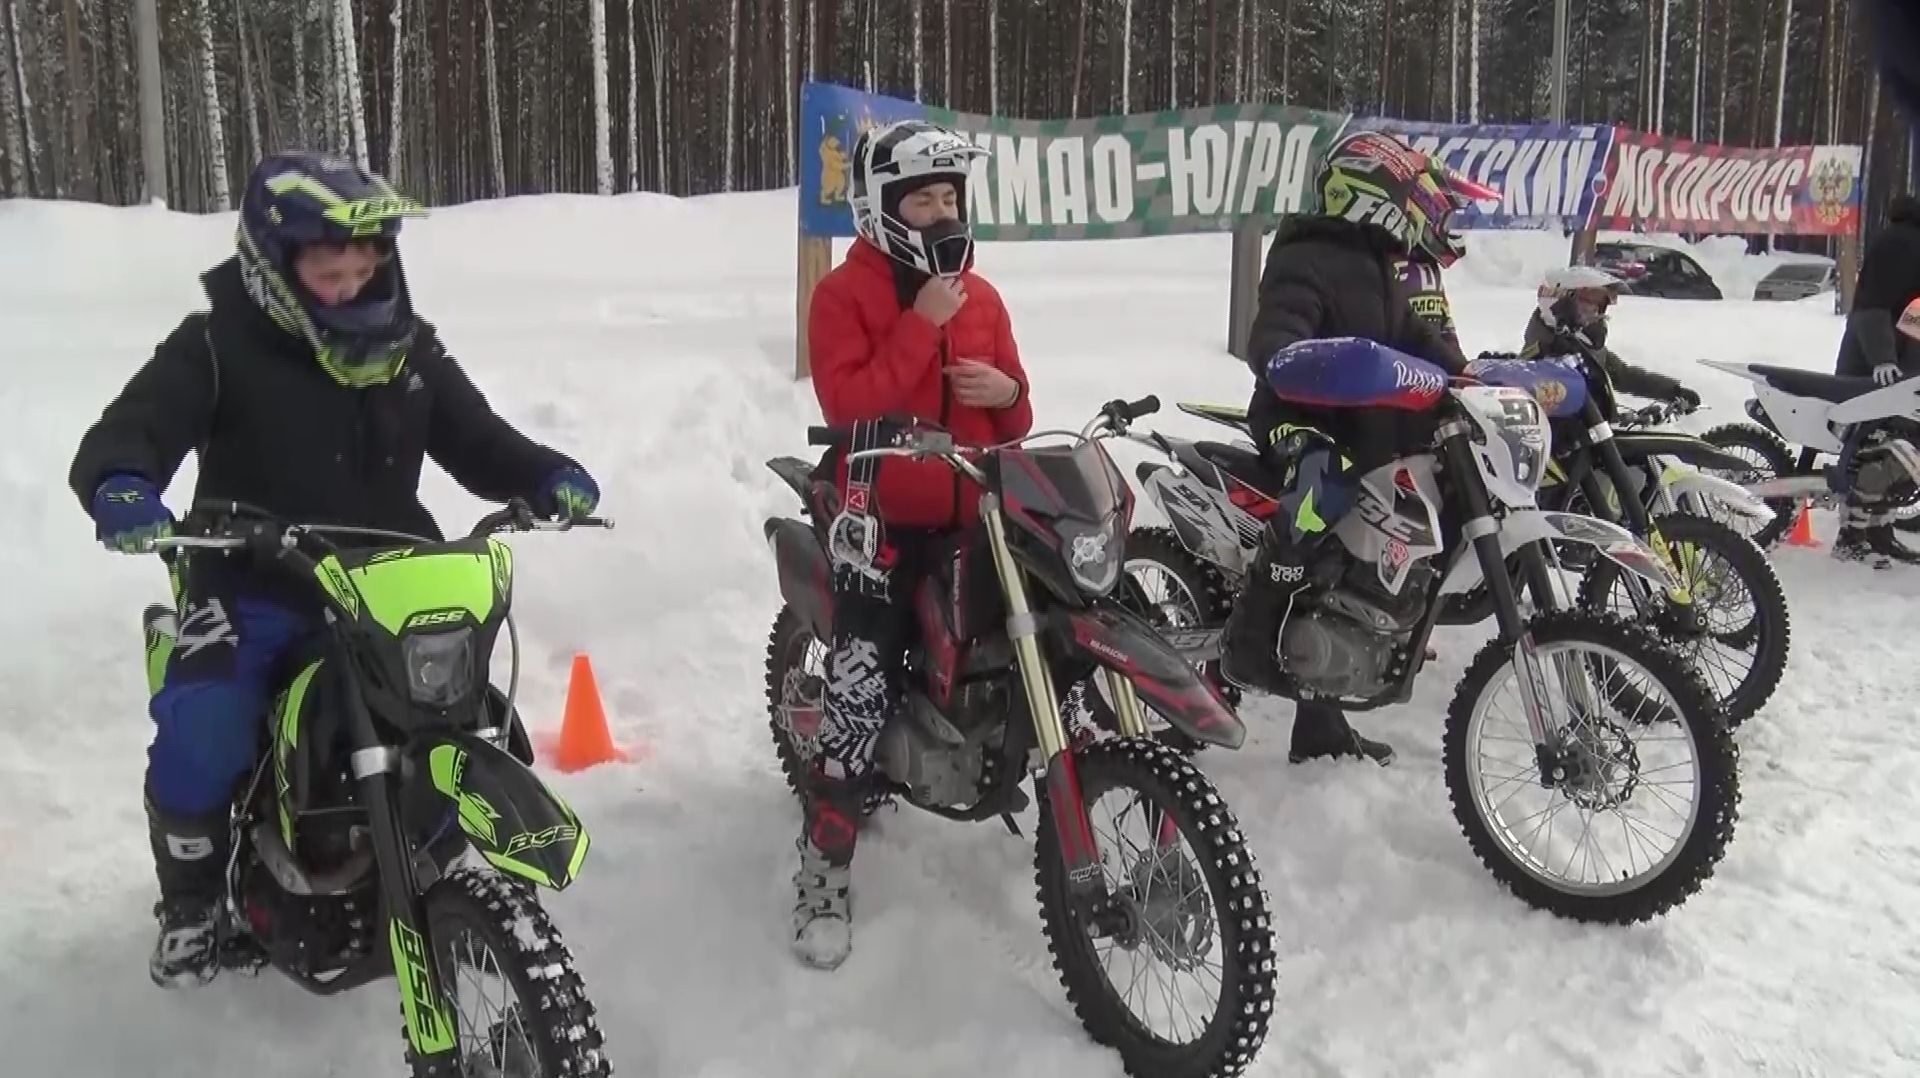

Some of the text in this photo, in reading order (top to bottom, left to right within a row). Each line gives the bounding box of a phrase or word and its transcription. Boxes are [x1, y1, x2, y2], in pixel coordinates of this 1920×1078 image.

[1602, 143, 1805, 222] МОТОКРОСС
[503, 824, 578, 857] BSE
[397, 918, 439, 1043] BSE
